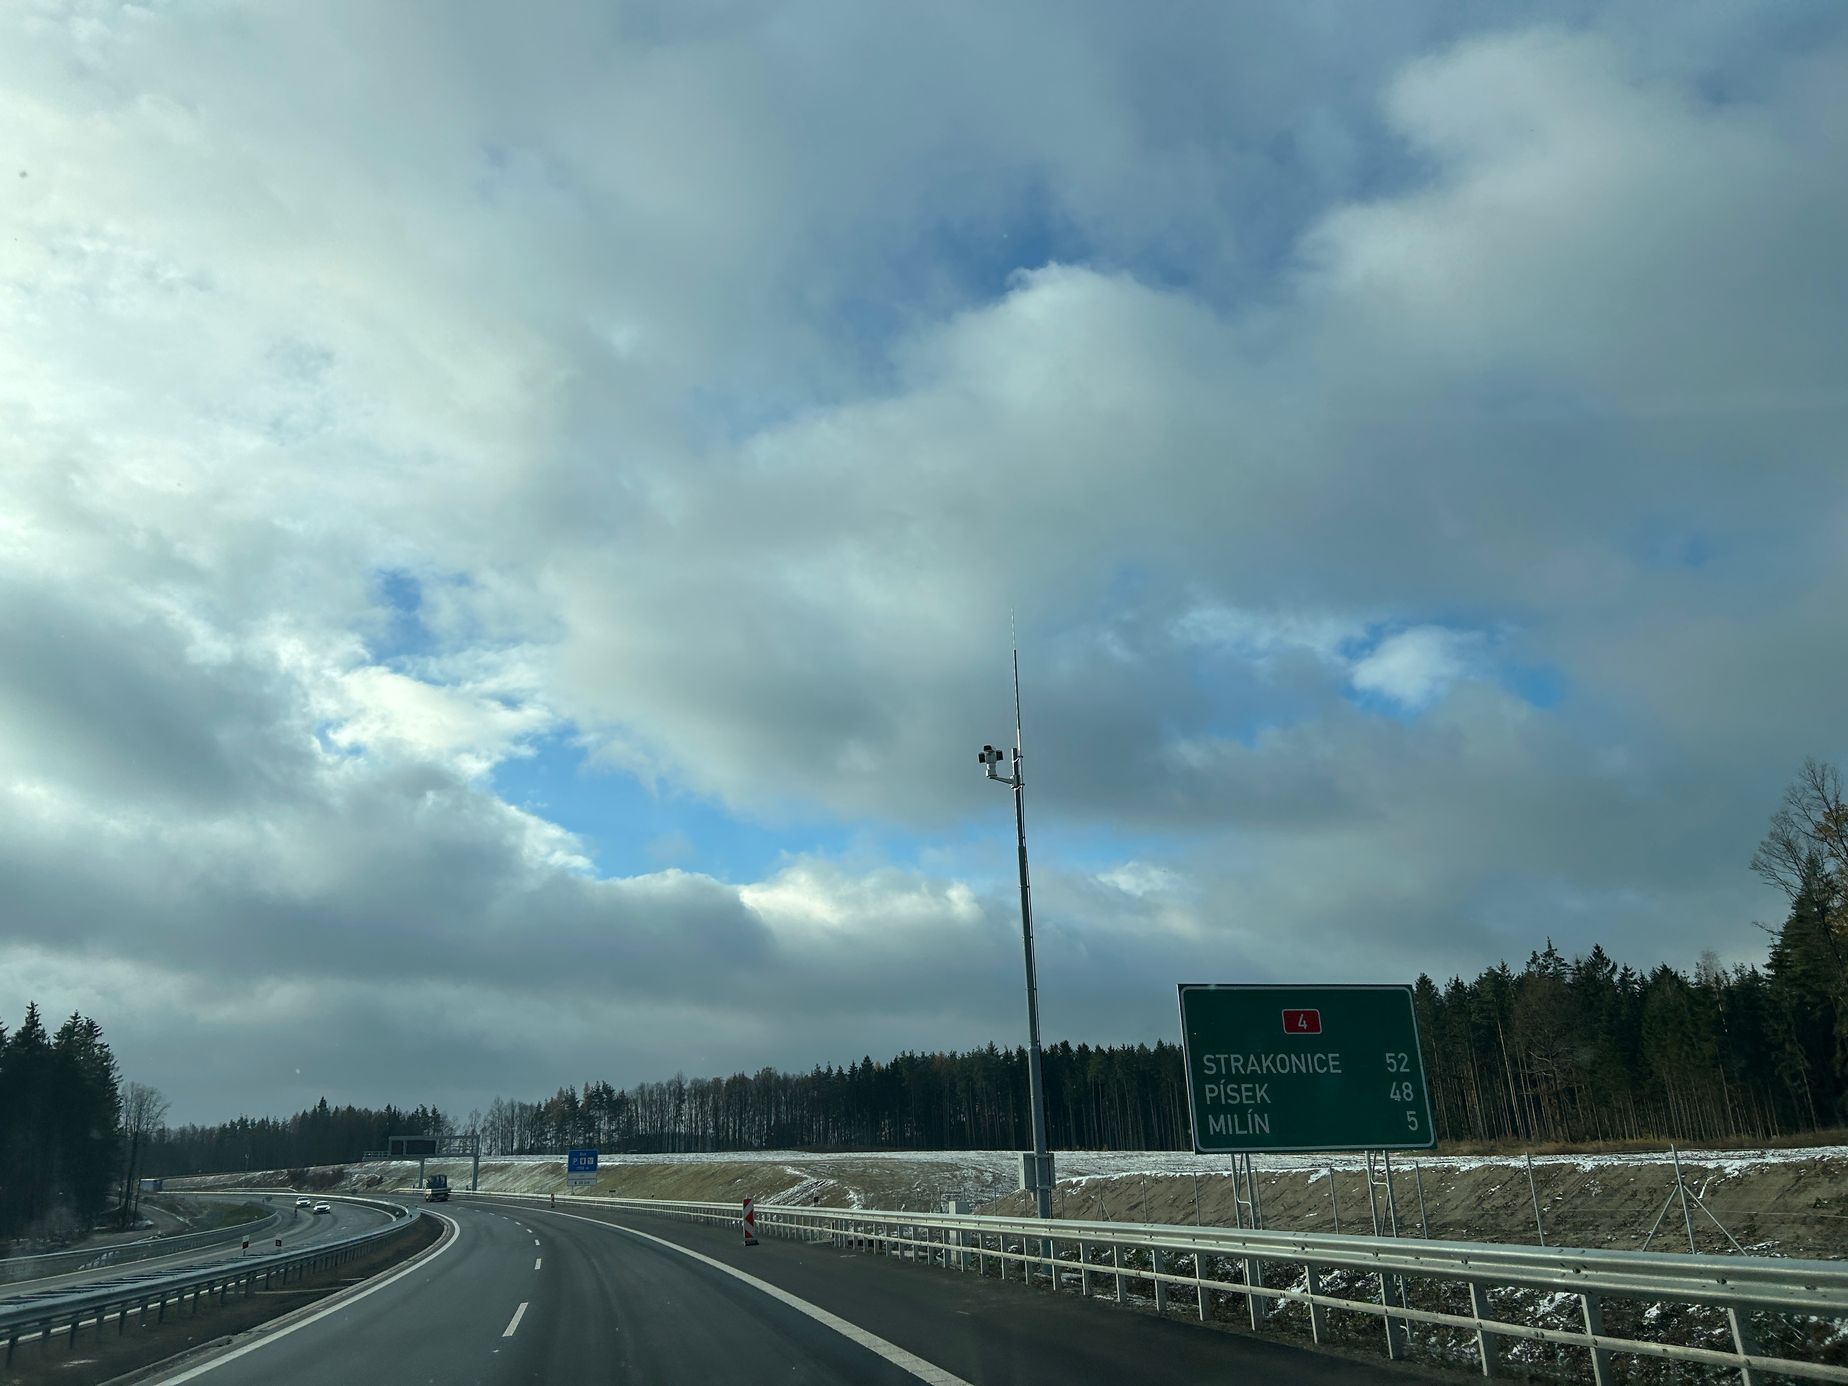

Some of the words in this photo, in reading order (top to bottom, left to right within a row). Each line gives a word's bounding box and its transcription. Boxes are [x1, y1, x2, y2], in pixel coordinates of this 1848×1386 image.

[1298, 1014, 1308, 1030] 4
[1203, 1053, 1342, 1074] STRAKONICE
[1386, 1053, 1410, 1073] 52
[1205, 1080, 1271, 1105] PÍSEK
[1390, 1082, 1414, 1102] 48
[1208, 1109, 1270, 1135] MILÍN
[1406, 1111, 1418, 1131] 5
